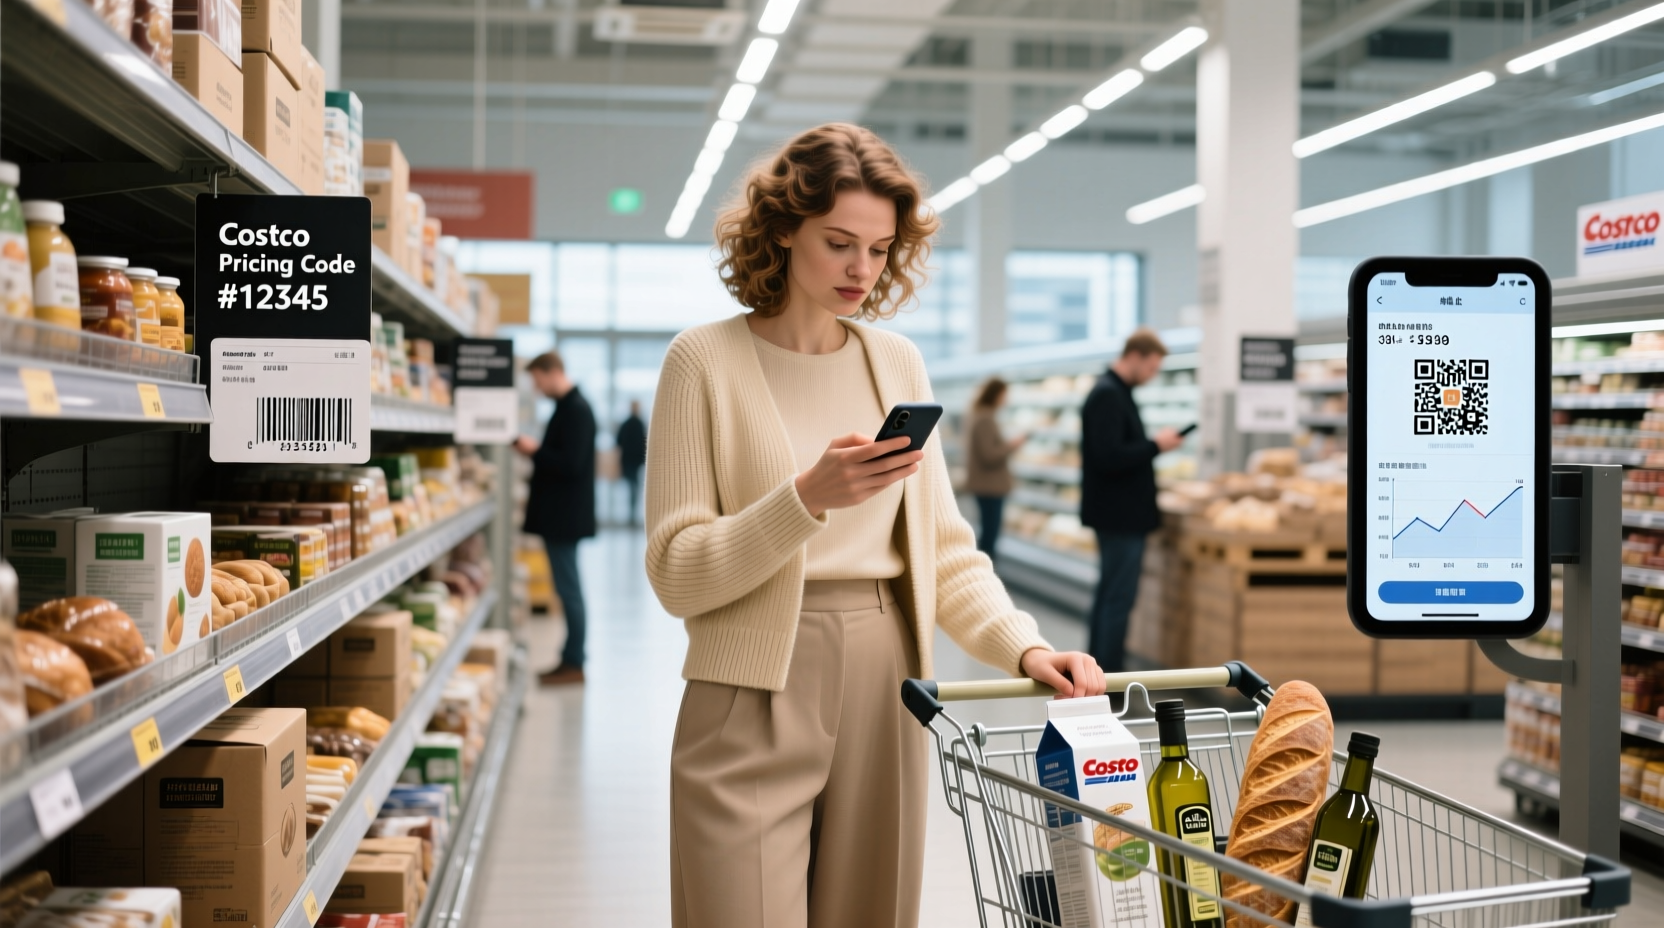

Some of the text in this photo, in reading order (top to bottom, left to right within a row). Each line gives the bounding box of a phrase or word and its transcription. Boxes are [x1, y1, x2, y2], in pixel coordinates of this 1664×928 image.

[219, 223, 310, 247] Costco
[220, 254, 355, 278] Pricing Code
[218, 283, 328, 310] #12345
